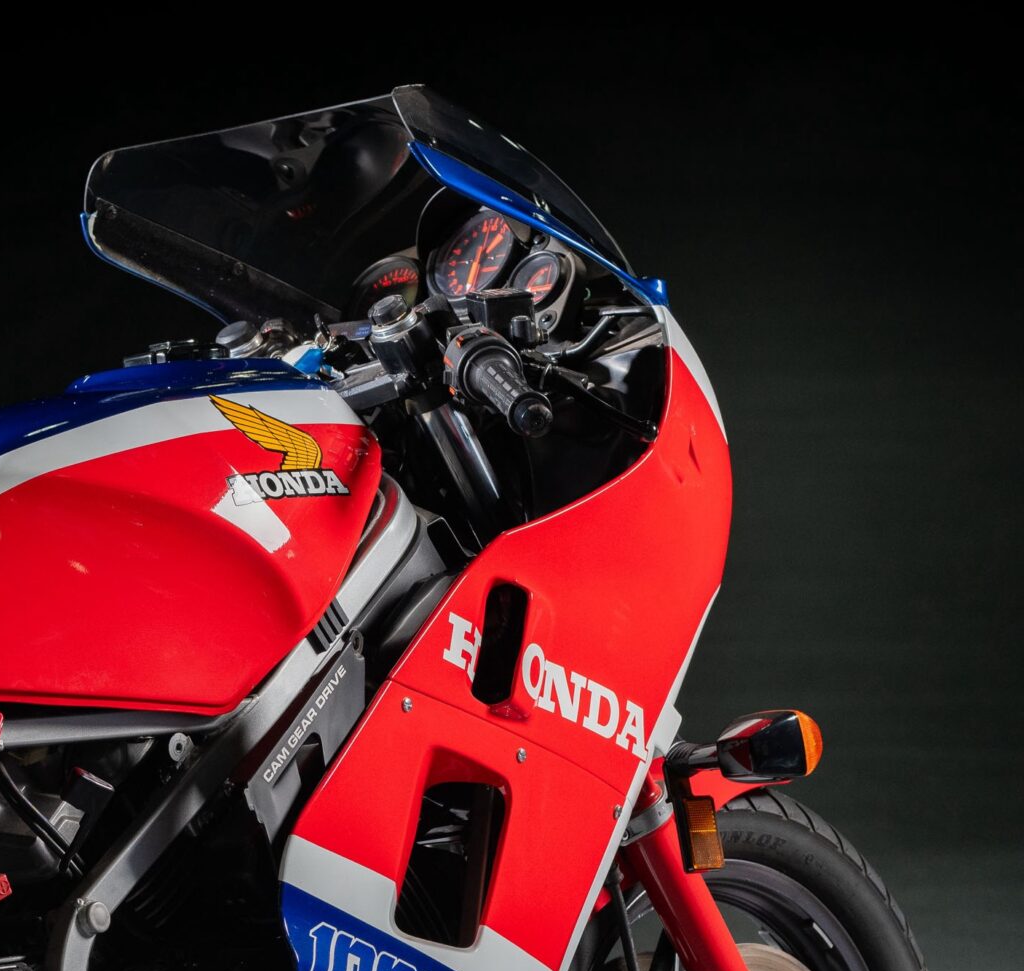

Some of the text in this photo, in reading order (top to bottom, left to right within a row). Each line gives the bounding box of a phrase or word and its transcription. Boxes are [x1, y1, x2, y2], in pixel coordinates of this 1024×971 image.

[228, 469, 351, 506] HONDA
[263, 664, 347, 783] CAM GEAR DRIVE
[443, 611, 651, 762] HONDA
